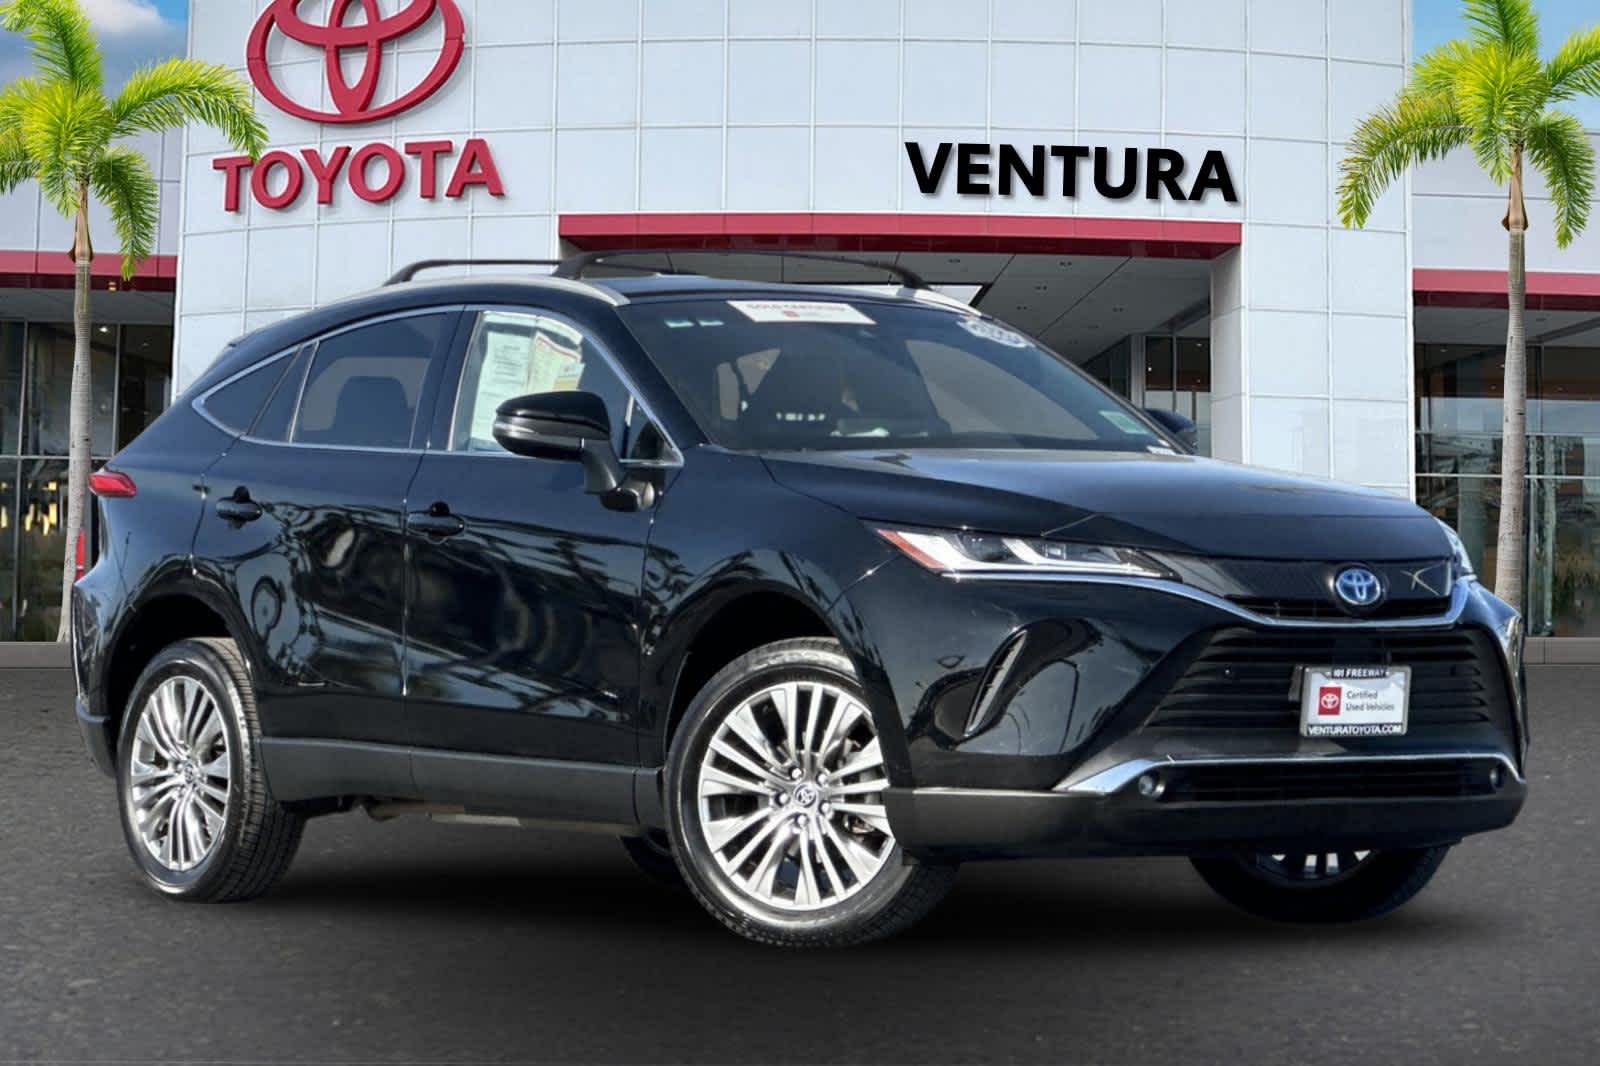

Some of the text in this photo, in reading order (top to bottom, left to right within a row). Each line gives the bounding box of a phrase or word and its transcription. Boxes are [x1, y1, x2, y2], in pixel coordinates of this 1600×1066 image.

[212, 138, 505, 212] TOYOTA
[905, 142, 1238, 202] VENTURA
[1346, 668, 1385, 677] FREEWAY
[1346, 690, 1378, 699] Certified
[1346, 703, 1395, 711] Used Vehicles
[1308, 725, 1402, 735] VENTURATOYOTA.COM
